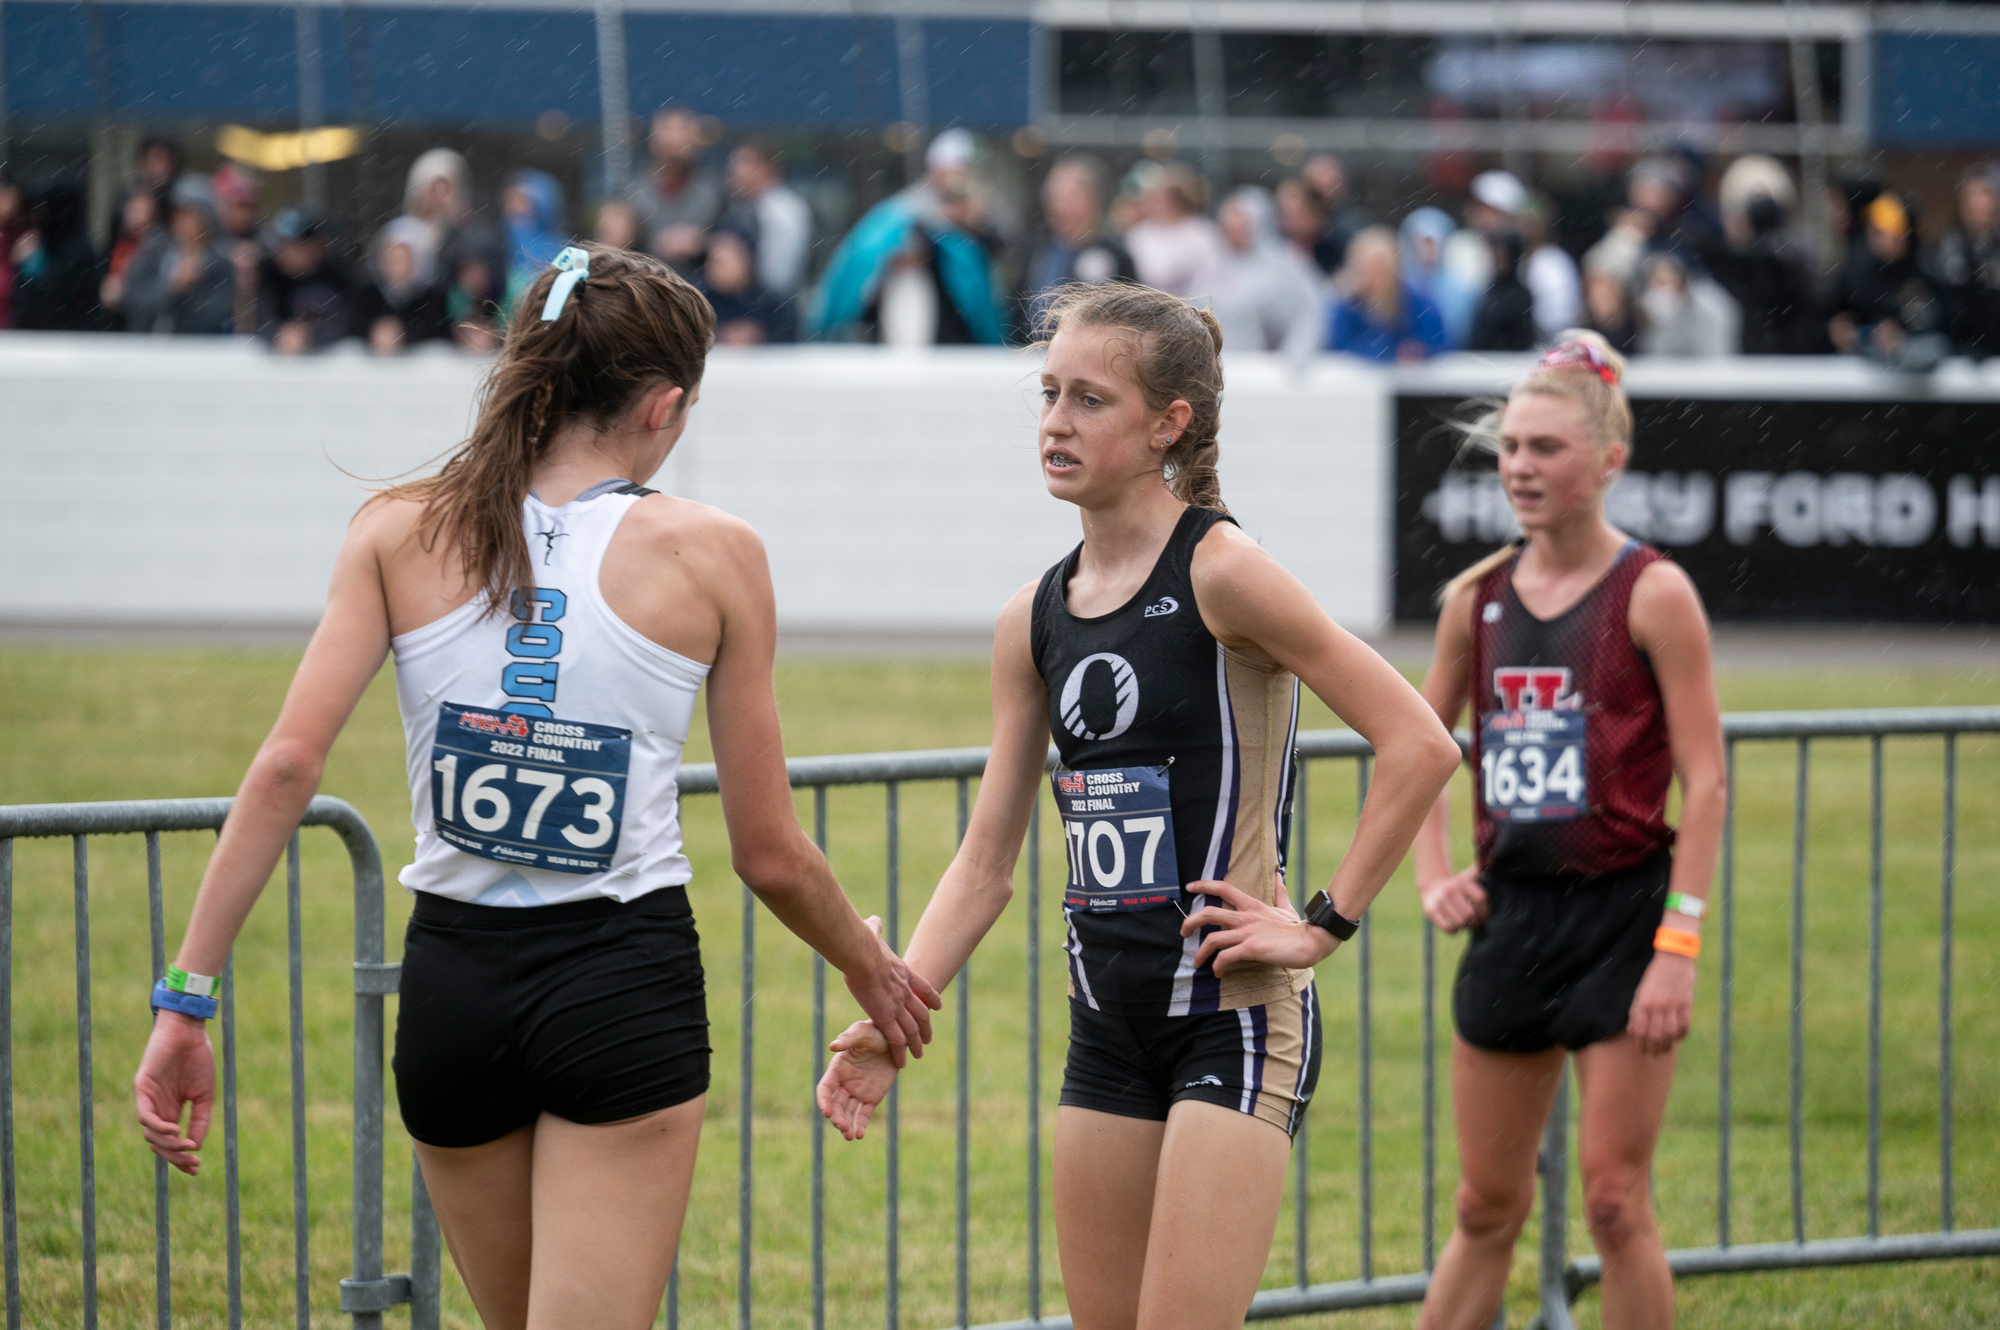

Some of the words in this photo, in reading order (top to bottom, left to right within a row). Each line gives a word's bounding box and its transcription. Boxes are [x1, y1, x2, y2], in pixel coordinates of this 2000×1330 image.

[1438, 471, 1717, 546] HRY
[1723, 471, 1938, 547] FORD
[1060, 652, 1139, 740] O
[533, 720, 585, 738] CROSS
[489, 740, 525, 757] 2022
[526, 745, 566, 763] FINAL
[531, 733, 602, 752] COUNTRY
[1086, 772, 1124, 785] CROSS
[1481, 745, 1585, 806] 1634
[1087, 781, 1140, 796] COUNTRY
[433, 754, 615, 849] 1673
[1071, 799, 1087, 812] 2022
[1087, 798, 1116, 812] FINAL
[1065, 815, 1166, 888] 1707
